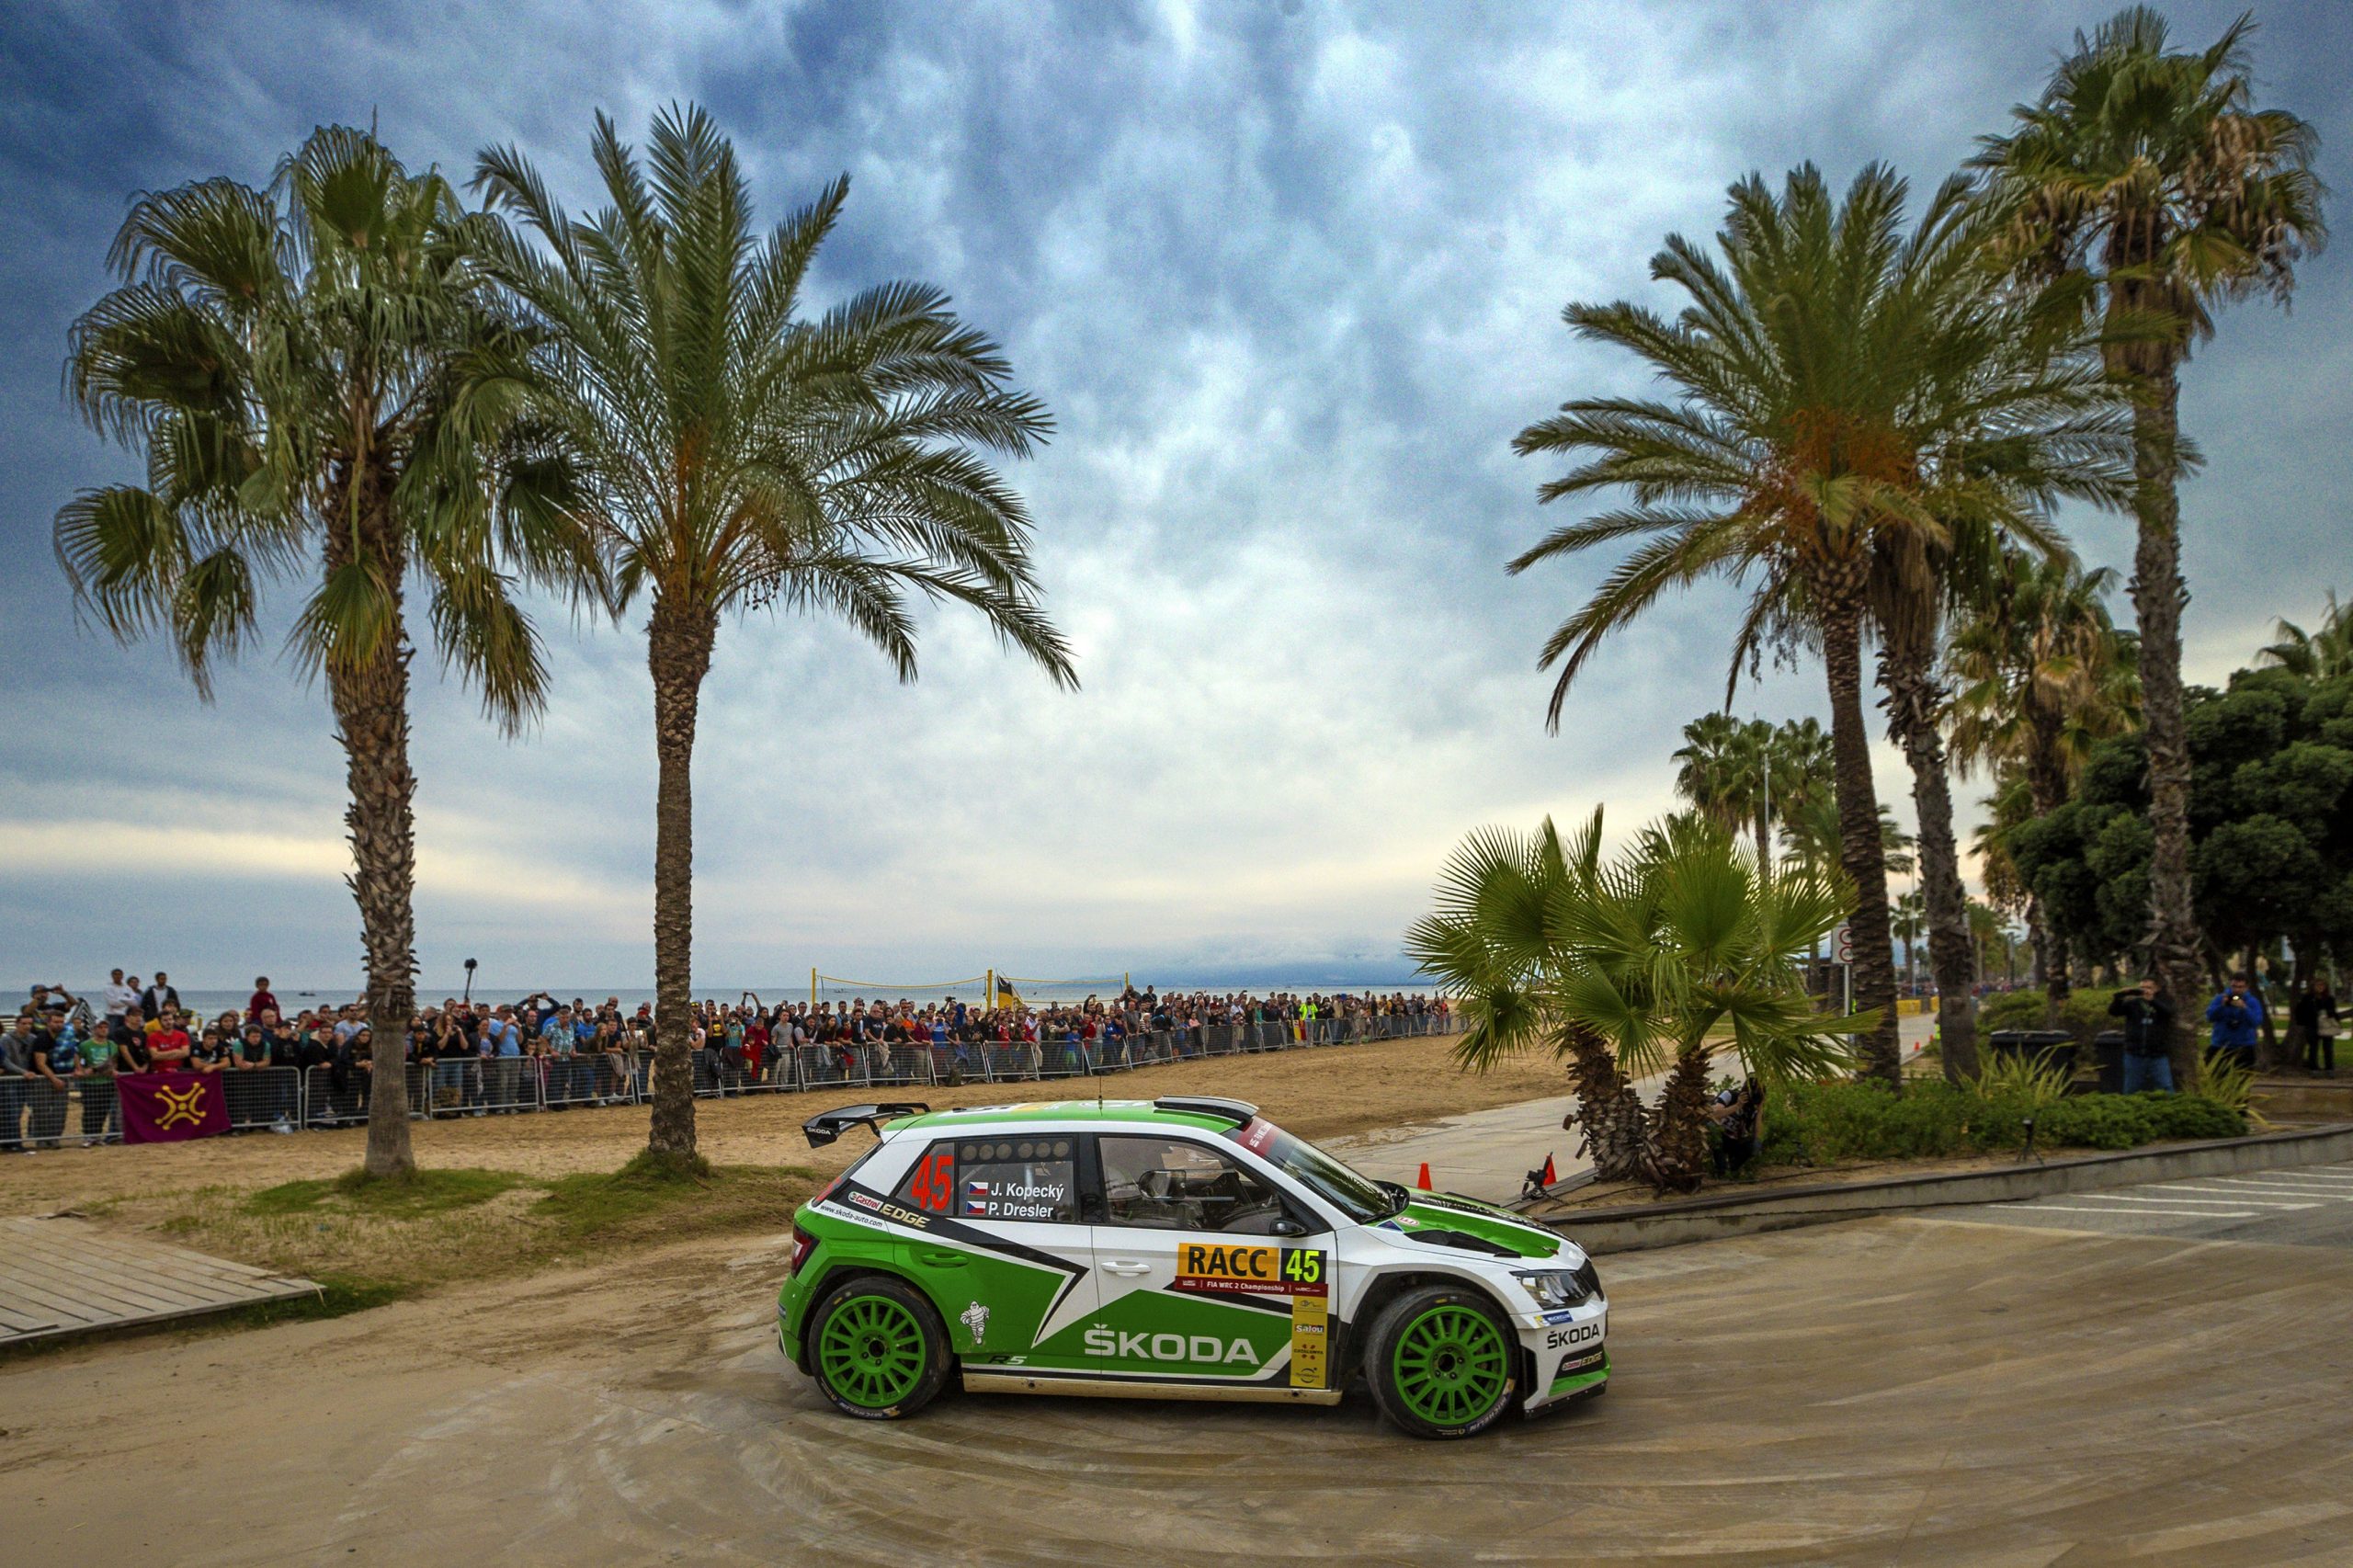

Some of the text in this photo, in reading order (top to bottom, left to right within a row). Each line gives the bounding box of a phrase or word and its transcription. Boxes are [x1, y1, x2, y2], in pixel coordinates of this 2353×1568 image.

[911, 1154, 954, 1211] 45
[991, 1182, 1064, 1201] J. Kopecký
[820, 1204, 883, 1228] www.skoda-auto.com
[855, 1194, 932, 1229] Castrol EDGE
[988, 1202, 1053, 1218] P. Dresler
[1188, 1245, 1268, 1278] RACC
[1286, 1249, 1320, 1283] 45
[1240, 1283, 1285, 1293] Championship
[1084, 1323, 1260, 1366] ŠKODA
[1547, 1324, 1600, 1350] ŠKODA
